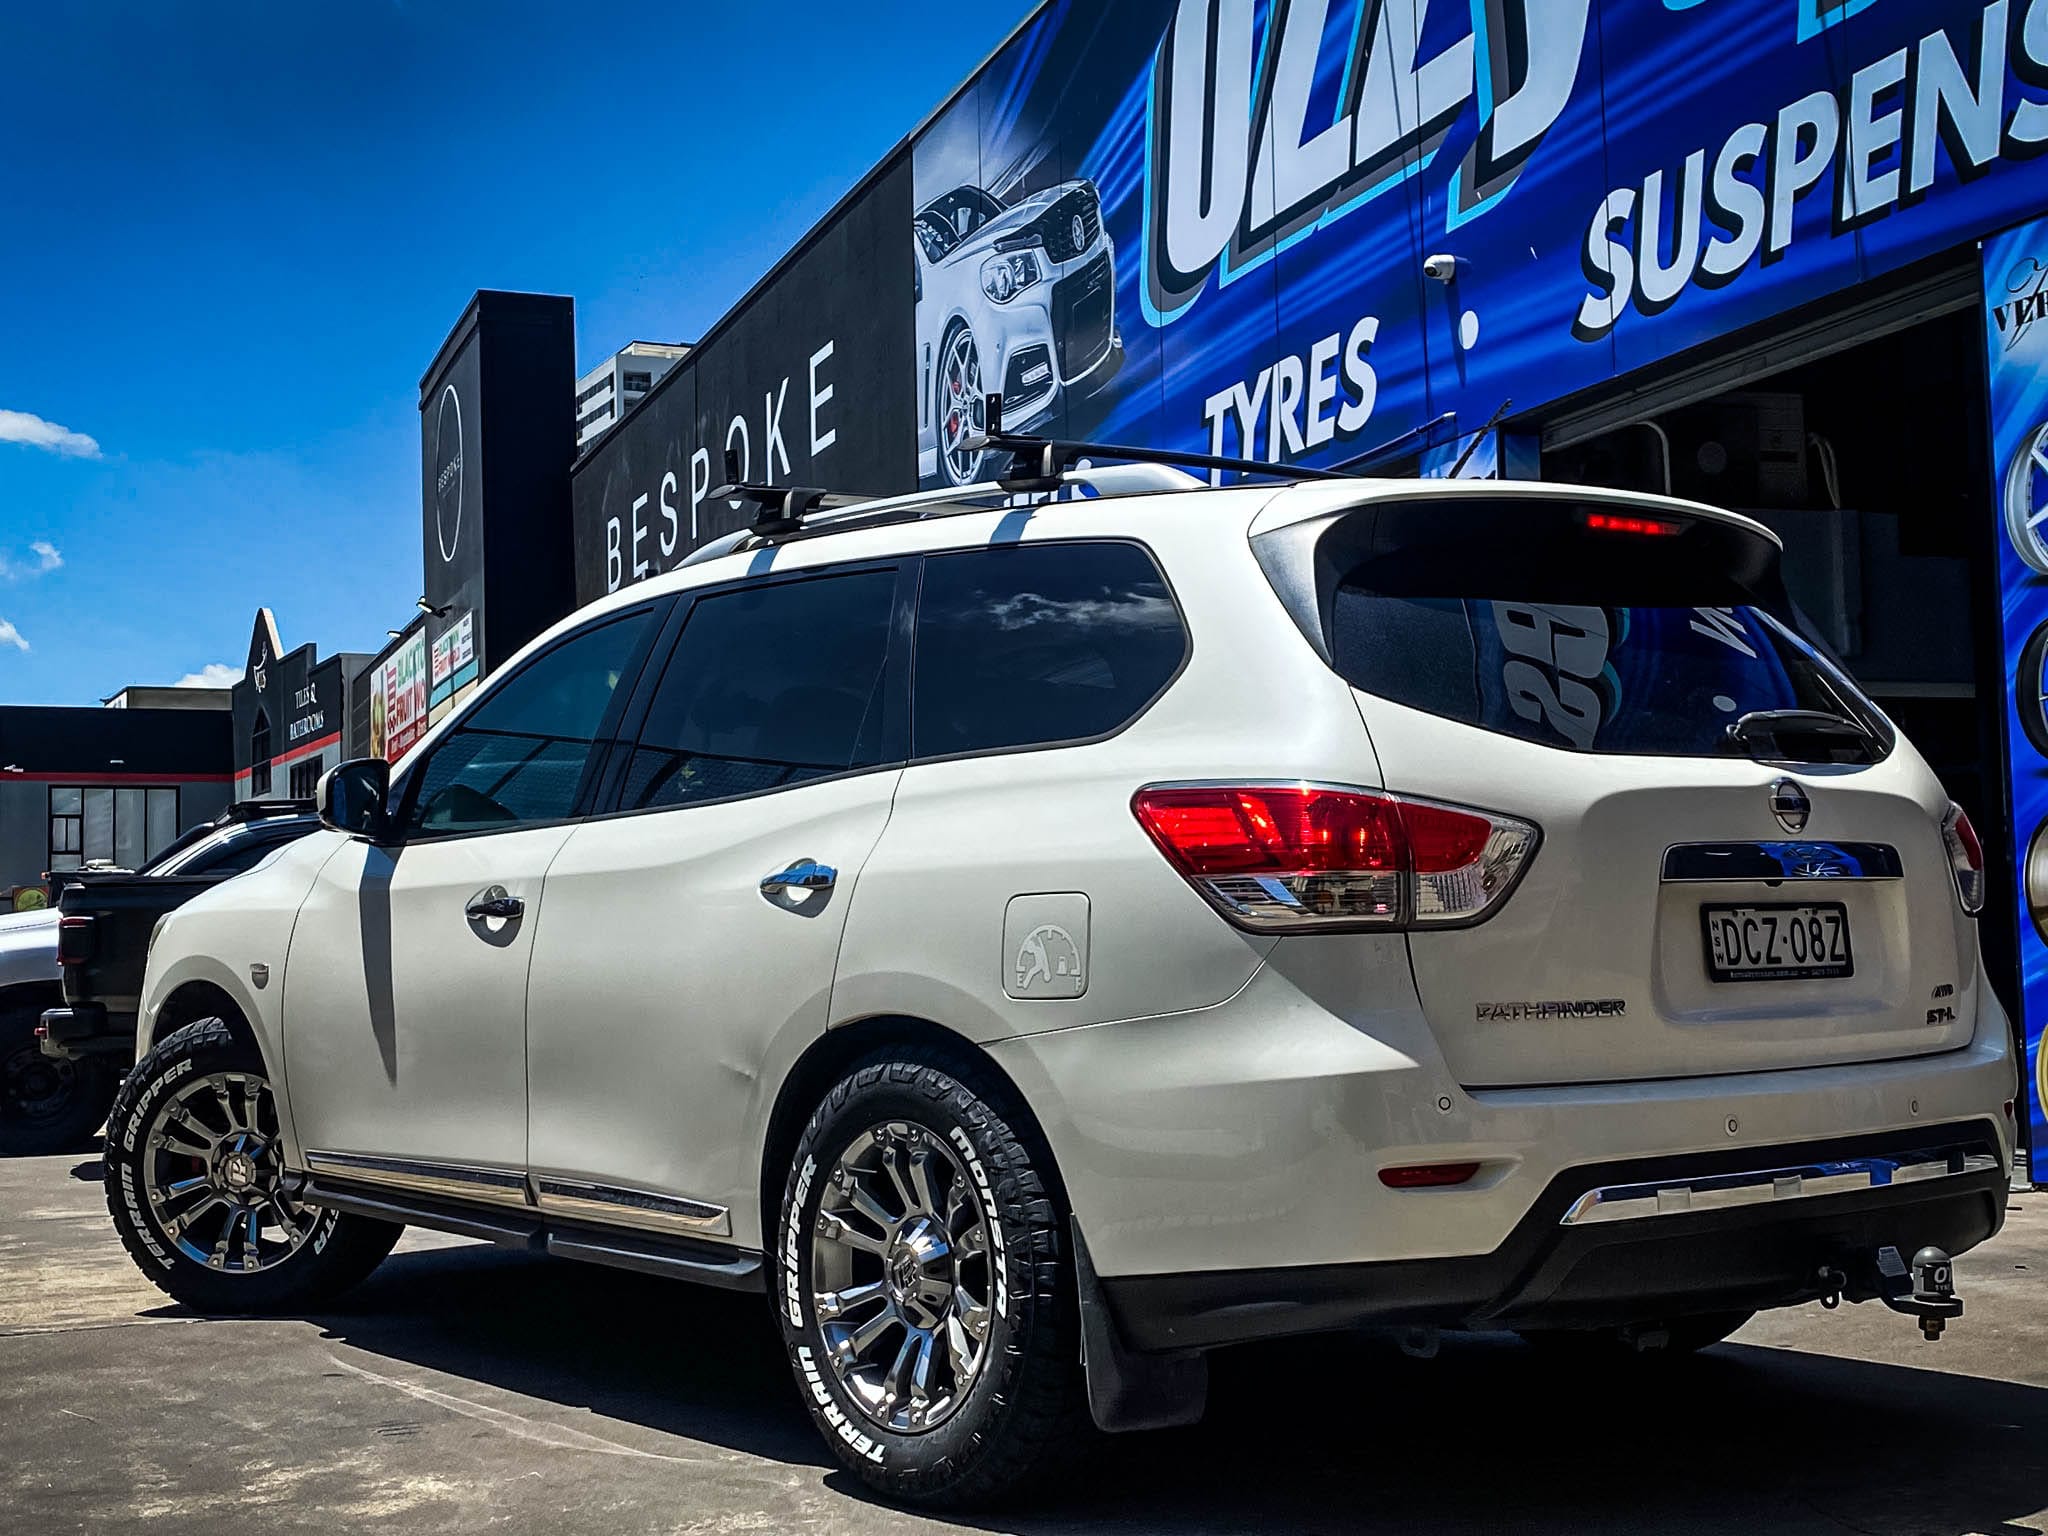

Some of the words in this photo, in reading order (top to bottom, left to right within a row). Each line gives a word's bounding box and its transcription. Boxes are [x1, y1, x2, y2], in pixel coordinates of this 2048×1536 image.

[1205, 316, 1379, 487] TYRES
[607, 340, 836, 594] BESPOKE
[1476, 999, 1626, 1021] PATHFINDER
[123, 1058, 193, 1153] GRIPPER
[121, 1162, 175, 1270] TERRAIN
[786, 1154, 817, 1328] GRIPPER
[799, 1347, 885, 1464] TERRAIN
